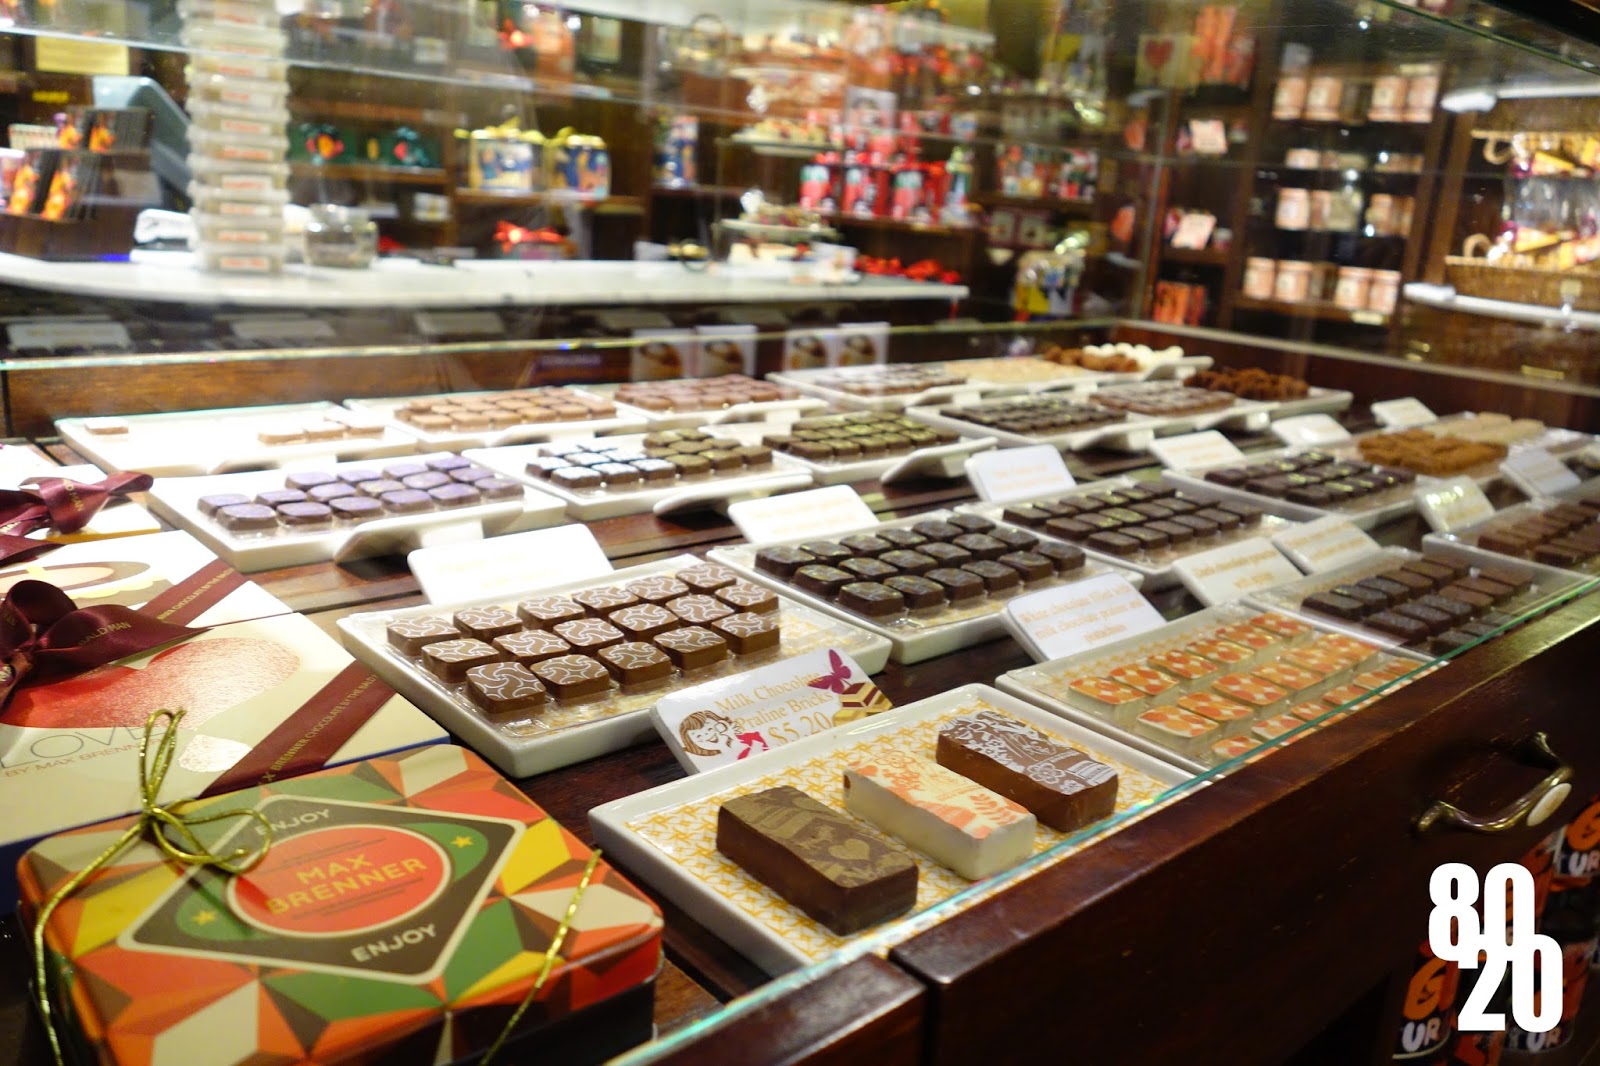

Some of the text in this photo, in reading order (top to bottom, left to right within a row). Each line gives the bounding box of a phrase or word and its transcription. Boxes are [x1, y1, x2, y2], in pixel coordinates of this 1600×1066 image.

[107, 621, 132, 633] MAN
[714, 670, 823, 713] Milk Chocolate
[736, 690, 834, 732] Praline Bricks
[768, 711, 833, 747] $5.20
[270, 736, 310, 771] BRENNER
[305, 703, 345, 740] CHOCOLATE
[5, 767, 30, 778] BY
[35, 759, 76, 771] MAX
[254, 808, 330, 837] ENJOY
[267, 858, 427, 915] BRENNER
[296, 853, 373, 885] MAX
[350, 923, 439, 963] ENJOY
